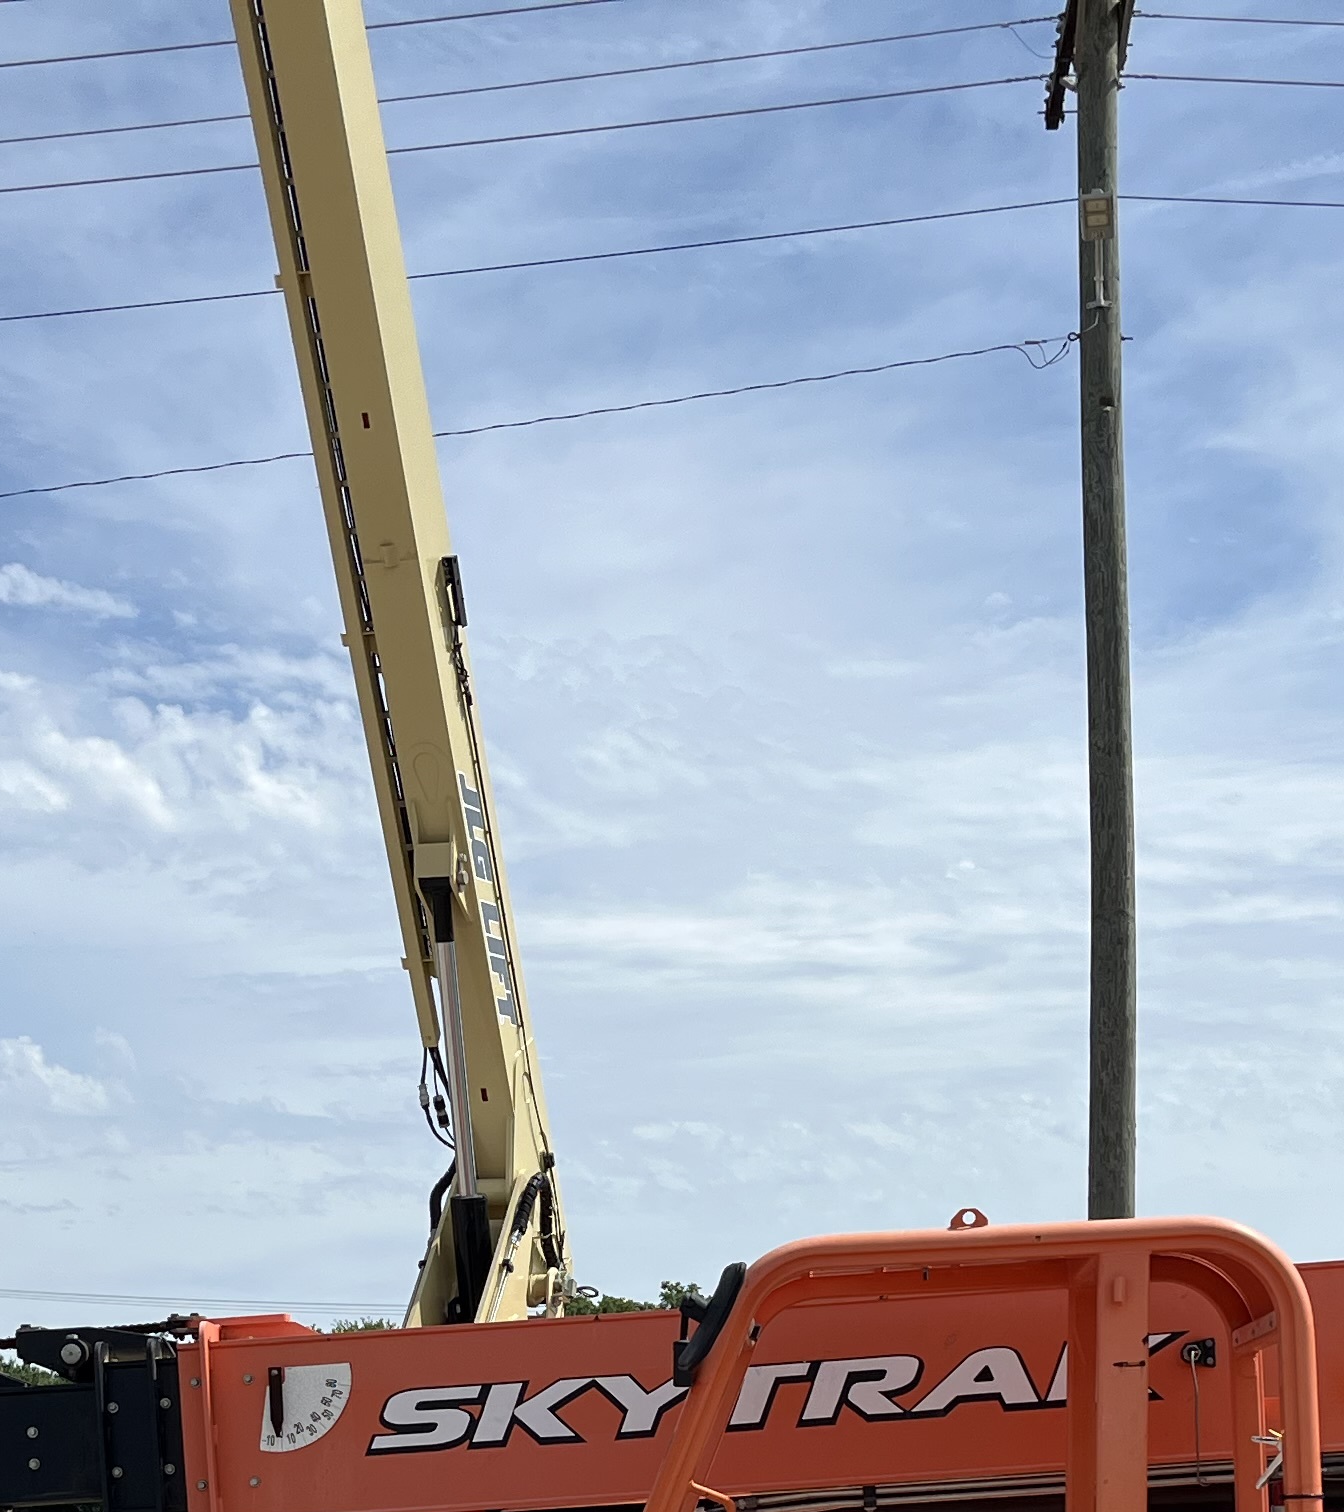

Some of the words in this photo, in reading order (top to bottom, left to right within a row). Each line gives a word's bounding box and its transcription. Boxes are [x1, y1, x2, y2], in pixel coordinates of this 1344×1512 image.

[457, 770, 493, 884] JLG
[478, 899, 519, 1028] LIFT
[294, 1422, 304, 1434] 20
[306, 1424, 317, 1436] 30
[287, 1433, 296, 1444] 10
